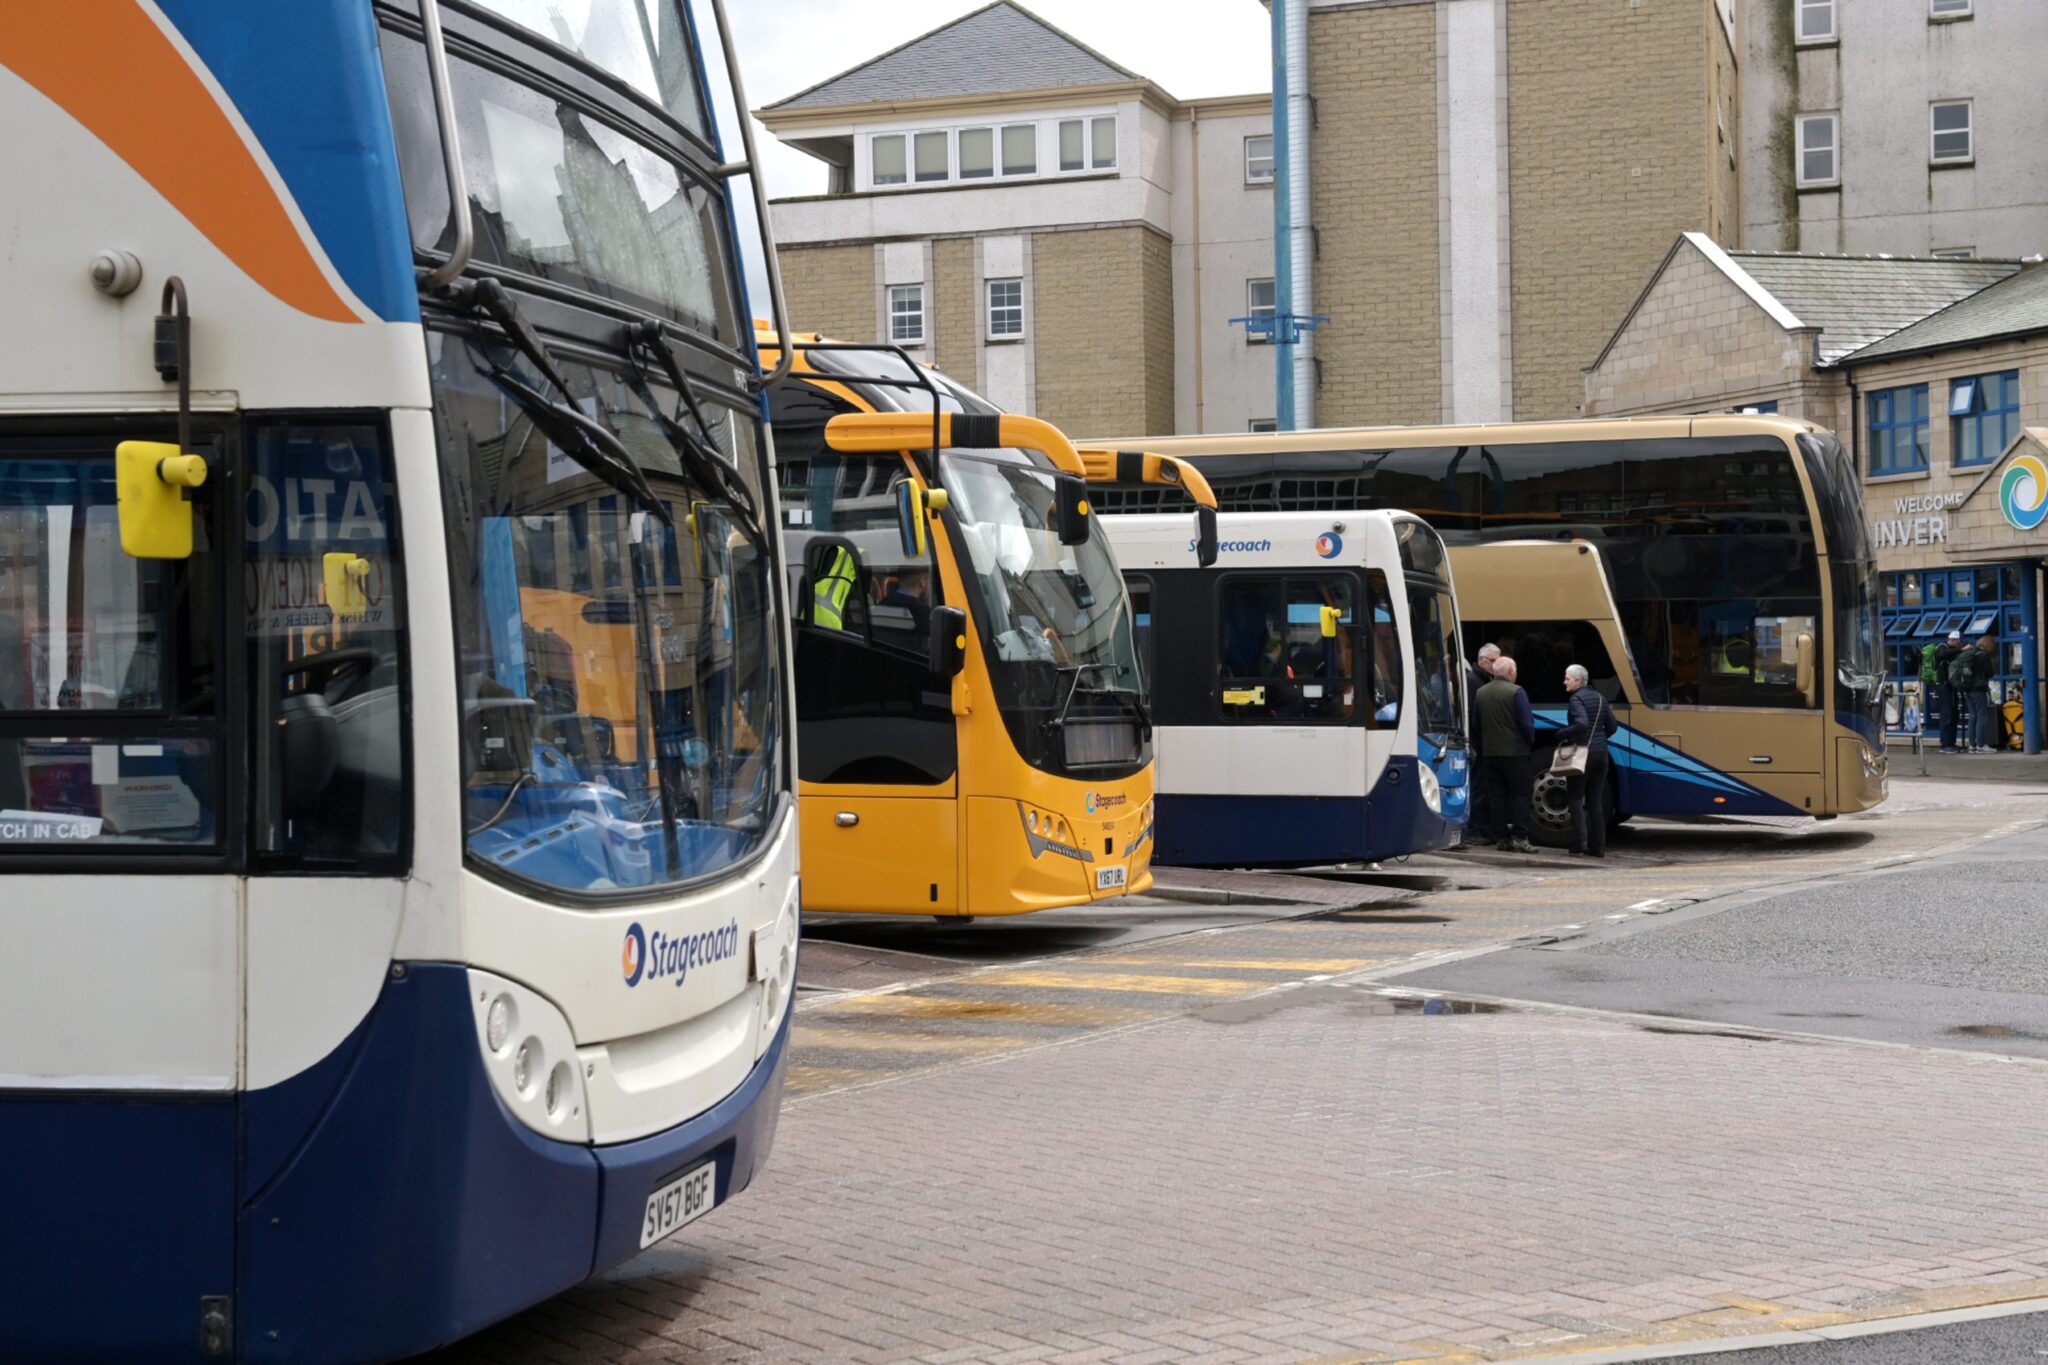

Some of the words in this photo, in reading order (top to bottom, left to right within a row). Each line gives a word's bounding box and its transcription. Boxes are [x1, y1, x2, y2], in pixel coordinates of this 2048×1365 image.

[1895, 493, 1964, 513] WELCOME
[1874, 517, 1949, 548] INVER
[1187, 539, 1271, 552] Secoach
[33, 823, 50, 838] IN
[57, 823, 92, 839] CAB
[647, 916, 738, 988] Stagecoach
[647, 1185, 682, 1239] SV57
[684, 1170, 710, 1217] BGF
